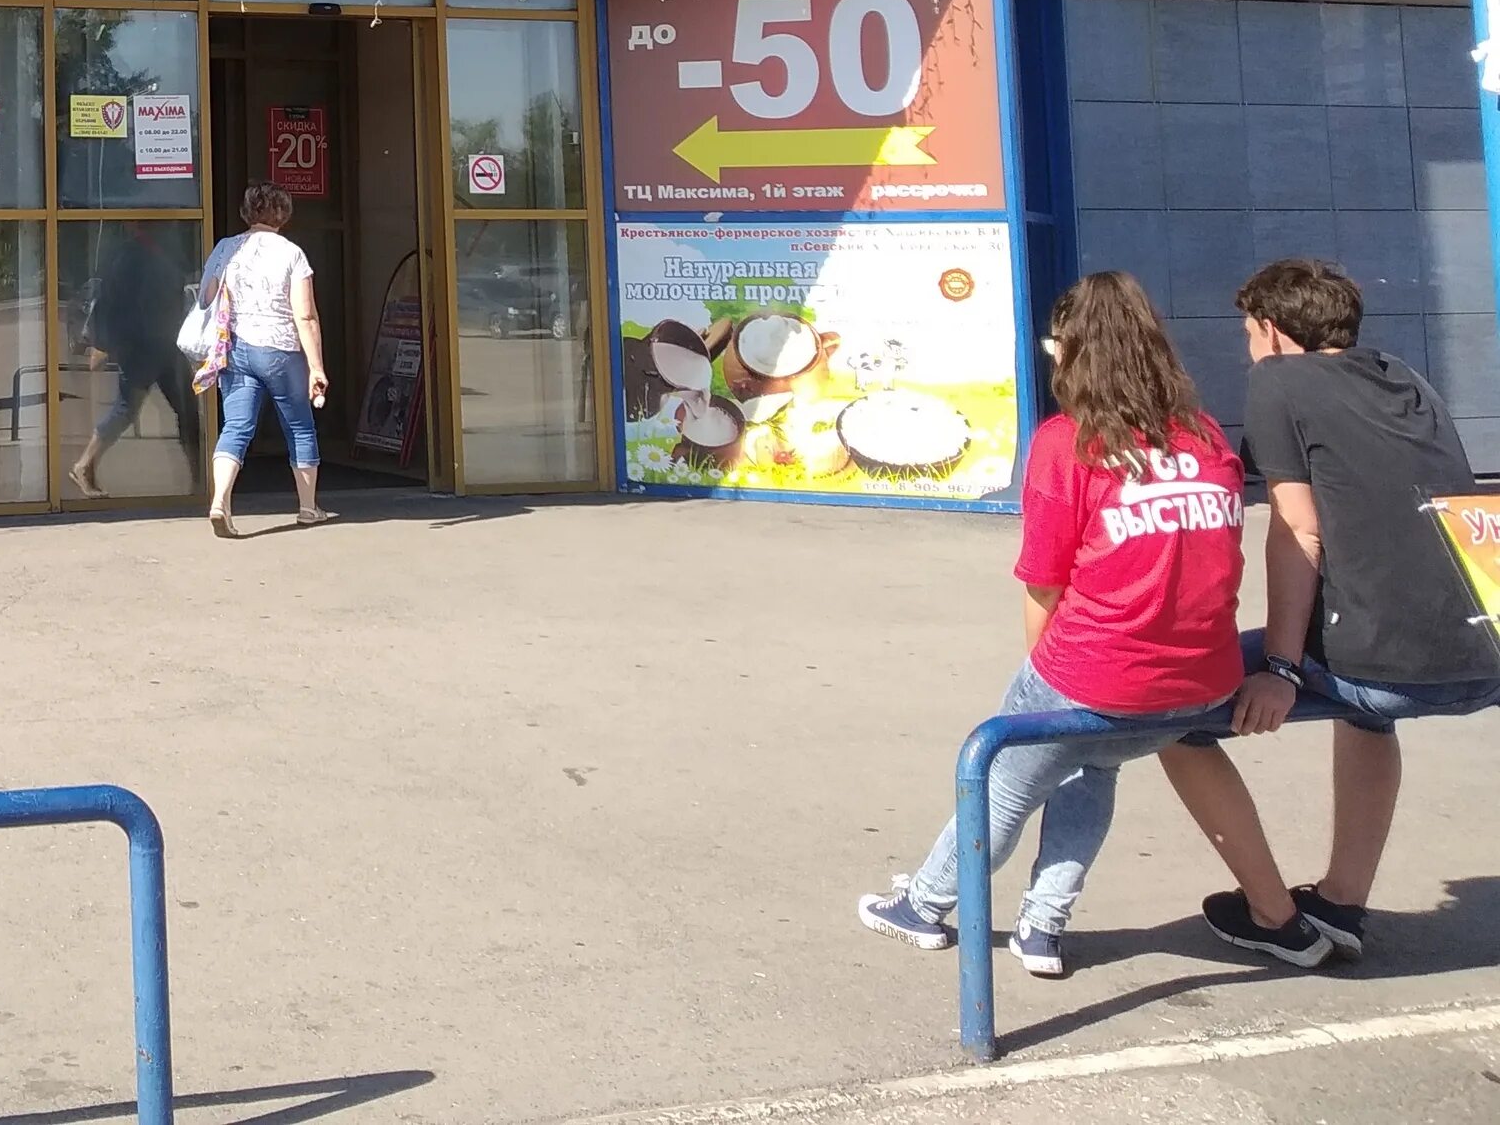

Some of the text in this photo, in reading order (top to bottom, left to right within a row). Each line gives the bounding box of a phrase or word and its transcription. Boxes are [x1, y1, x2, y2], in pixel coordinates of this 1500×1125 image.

[628, 22, 677, 51] до
[138, 101, 186, 121] MAXIMA
[276, 121, 317, 132] СКИДКА
[284, 174, 312, 182] НОВАЯ
[623, 183, 988, 202] ТЦ Максима, 1й этаж рассрочка
[620, 227, 802, 240] Крестьянско-фермерское
[664, 257, 818, 283] Натуральная
[626, 283, 738, 302] молочная
[1101, 491, 1245, 546] ВЫСТАВКА
[873, 919, 921, 948] CONVERSE
